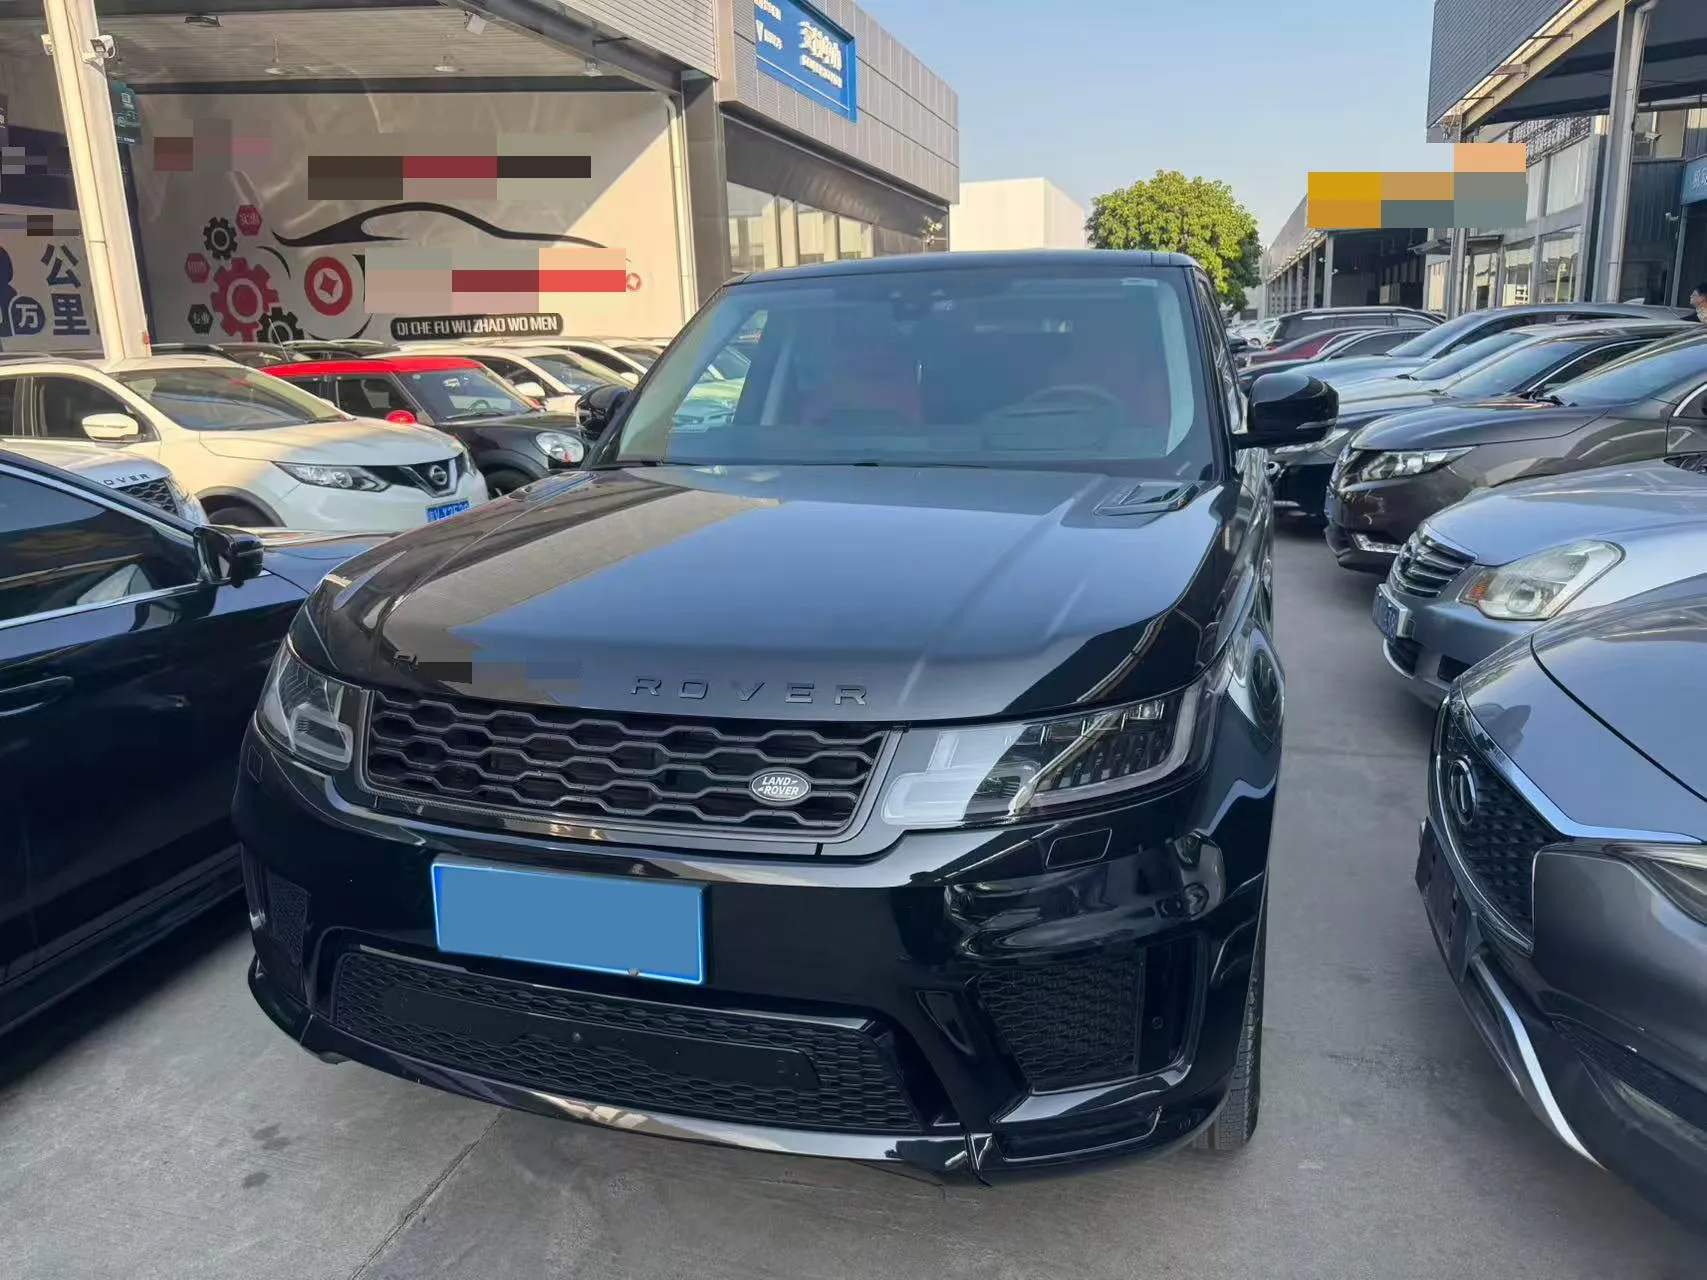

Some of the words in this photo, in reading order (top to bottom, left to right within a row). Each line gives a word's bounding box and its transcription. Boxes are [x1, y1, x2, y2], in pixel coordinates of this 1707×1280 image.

[41, 244, 90, 335] 公里
[16, 304, 38, 328] 万
[411, 321, 432, 335] CHE
[434, 320, 450, 333] FU
[451, 319, 472, 333] WU
[473, 318, 506, 333] ZHAO
[507, 317, 529, 331] WO
[530, 315, 557, 331] MEN
[104, 473, 149, 485] OVER
[630, 676, 868, 705] ROVER
[762, 776, 791, 786] LAND
[763, 785, 799, 796] ROVER
